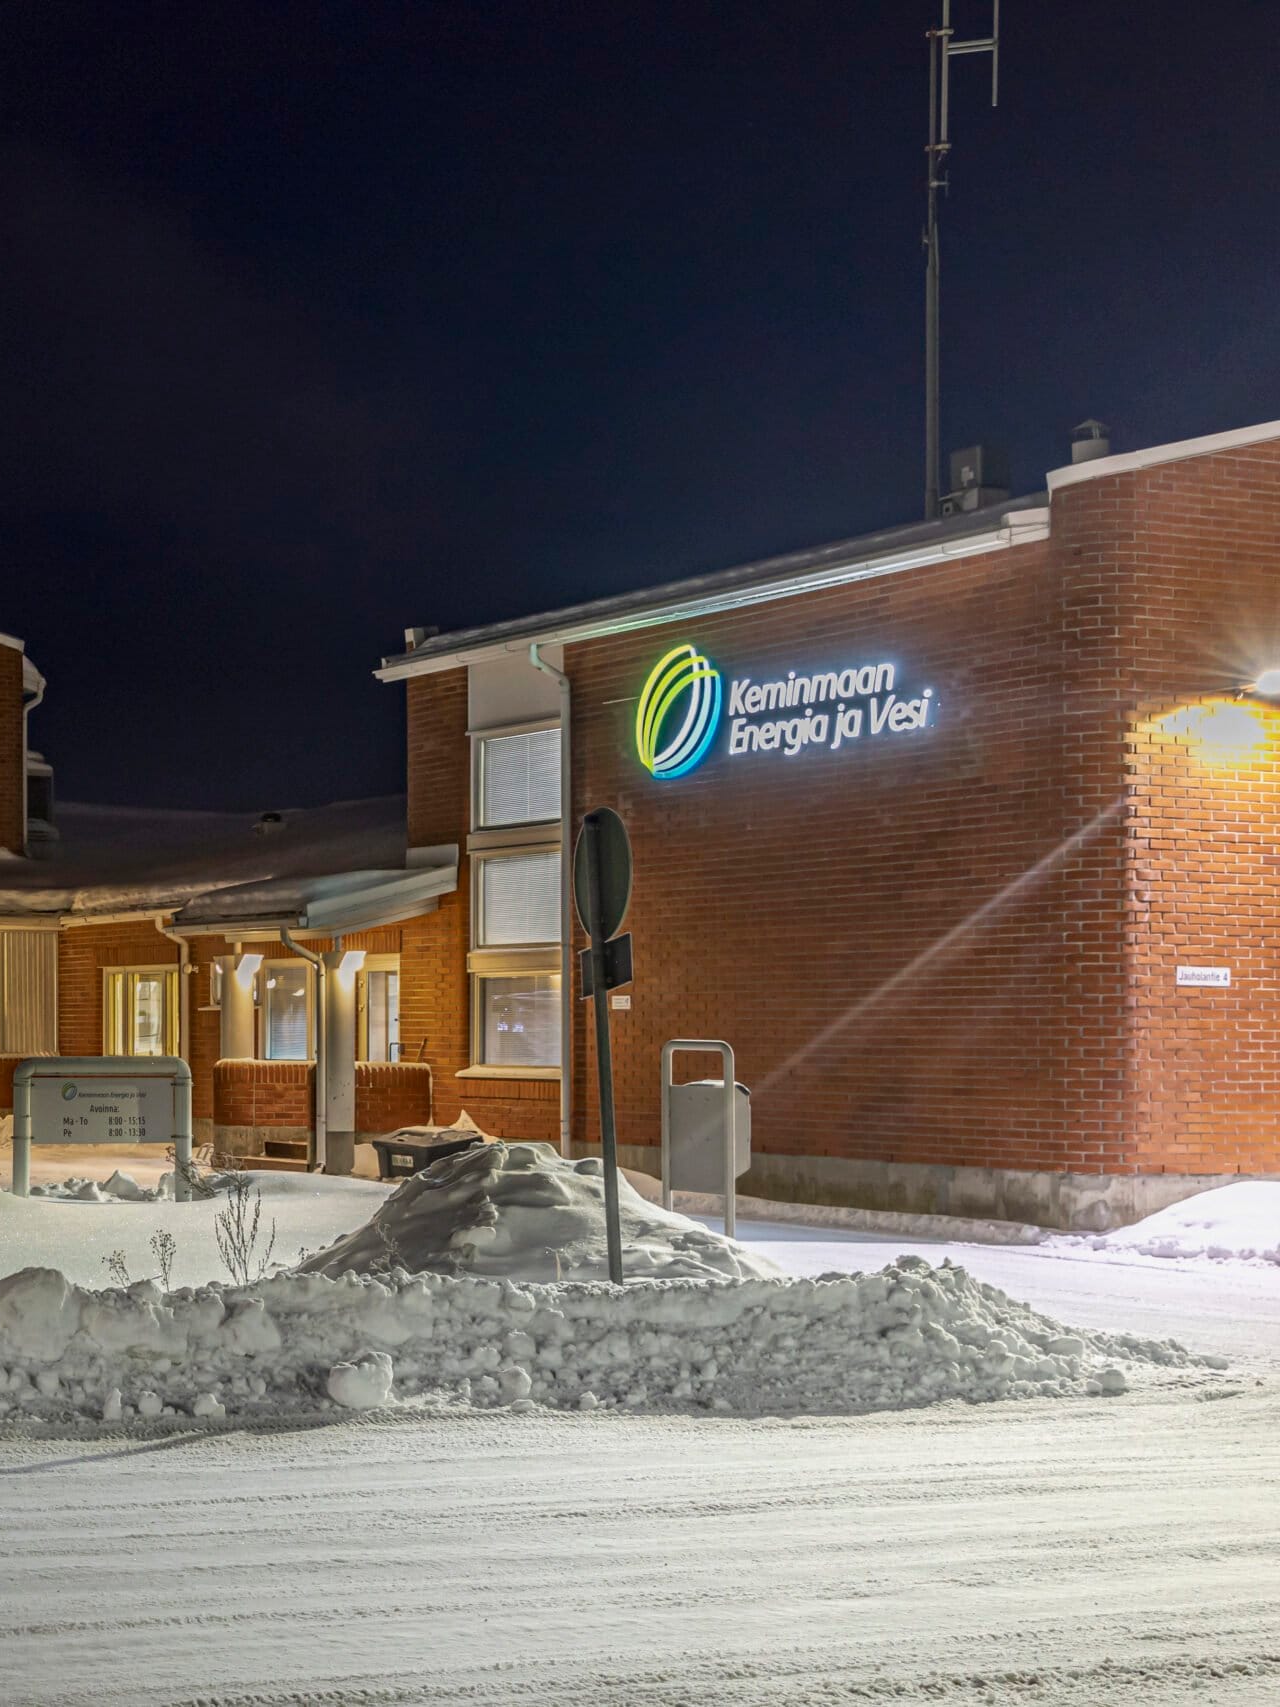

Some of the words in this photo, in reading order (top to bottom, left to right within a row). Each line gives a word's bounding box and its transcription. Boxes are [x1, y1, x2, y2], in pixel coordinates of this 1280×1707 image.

[728, 663, 895, 716] Keminmaan
[729, 708, 829, 756] Energia
[830, 703, 863, 750] ja
[870, 688, 933, 735] Vesi
[1223, 972, 1228, 981] 4
[89, 1104, 120, 1113] Avoinna:
[63, 1116, 74, 1125] Ma
[80, 1116, 89, 1125] To
[108, 1116, 123, 1125] 8:00
[63, 1128, 72, 1137] Pe
[108, 1128, 123, 1137] 8:00
